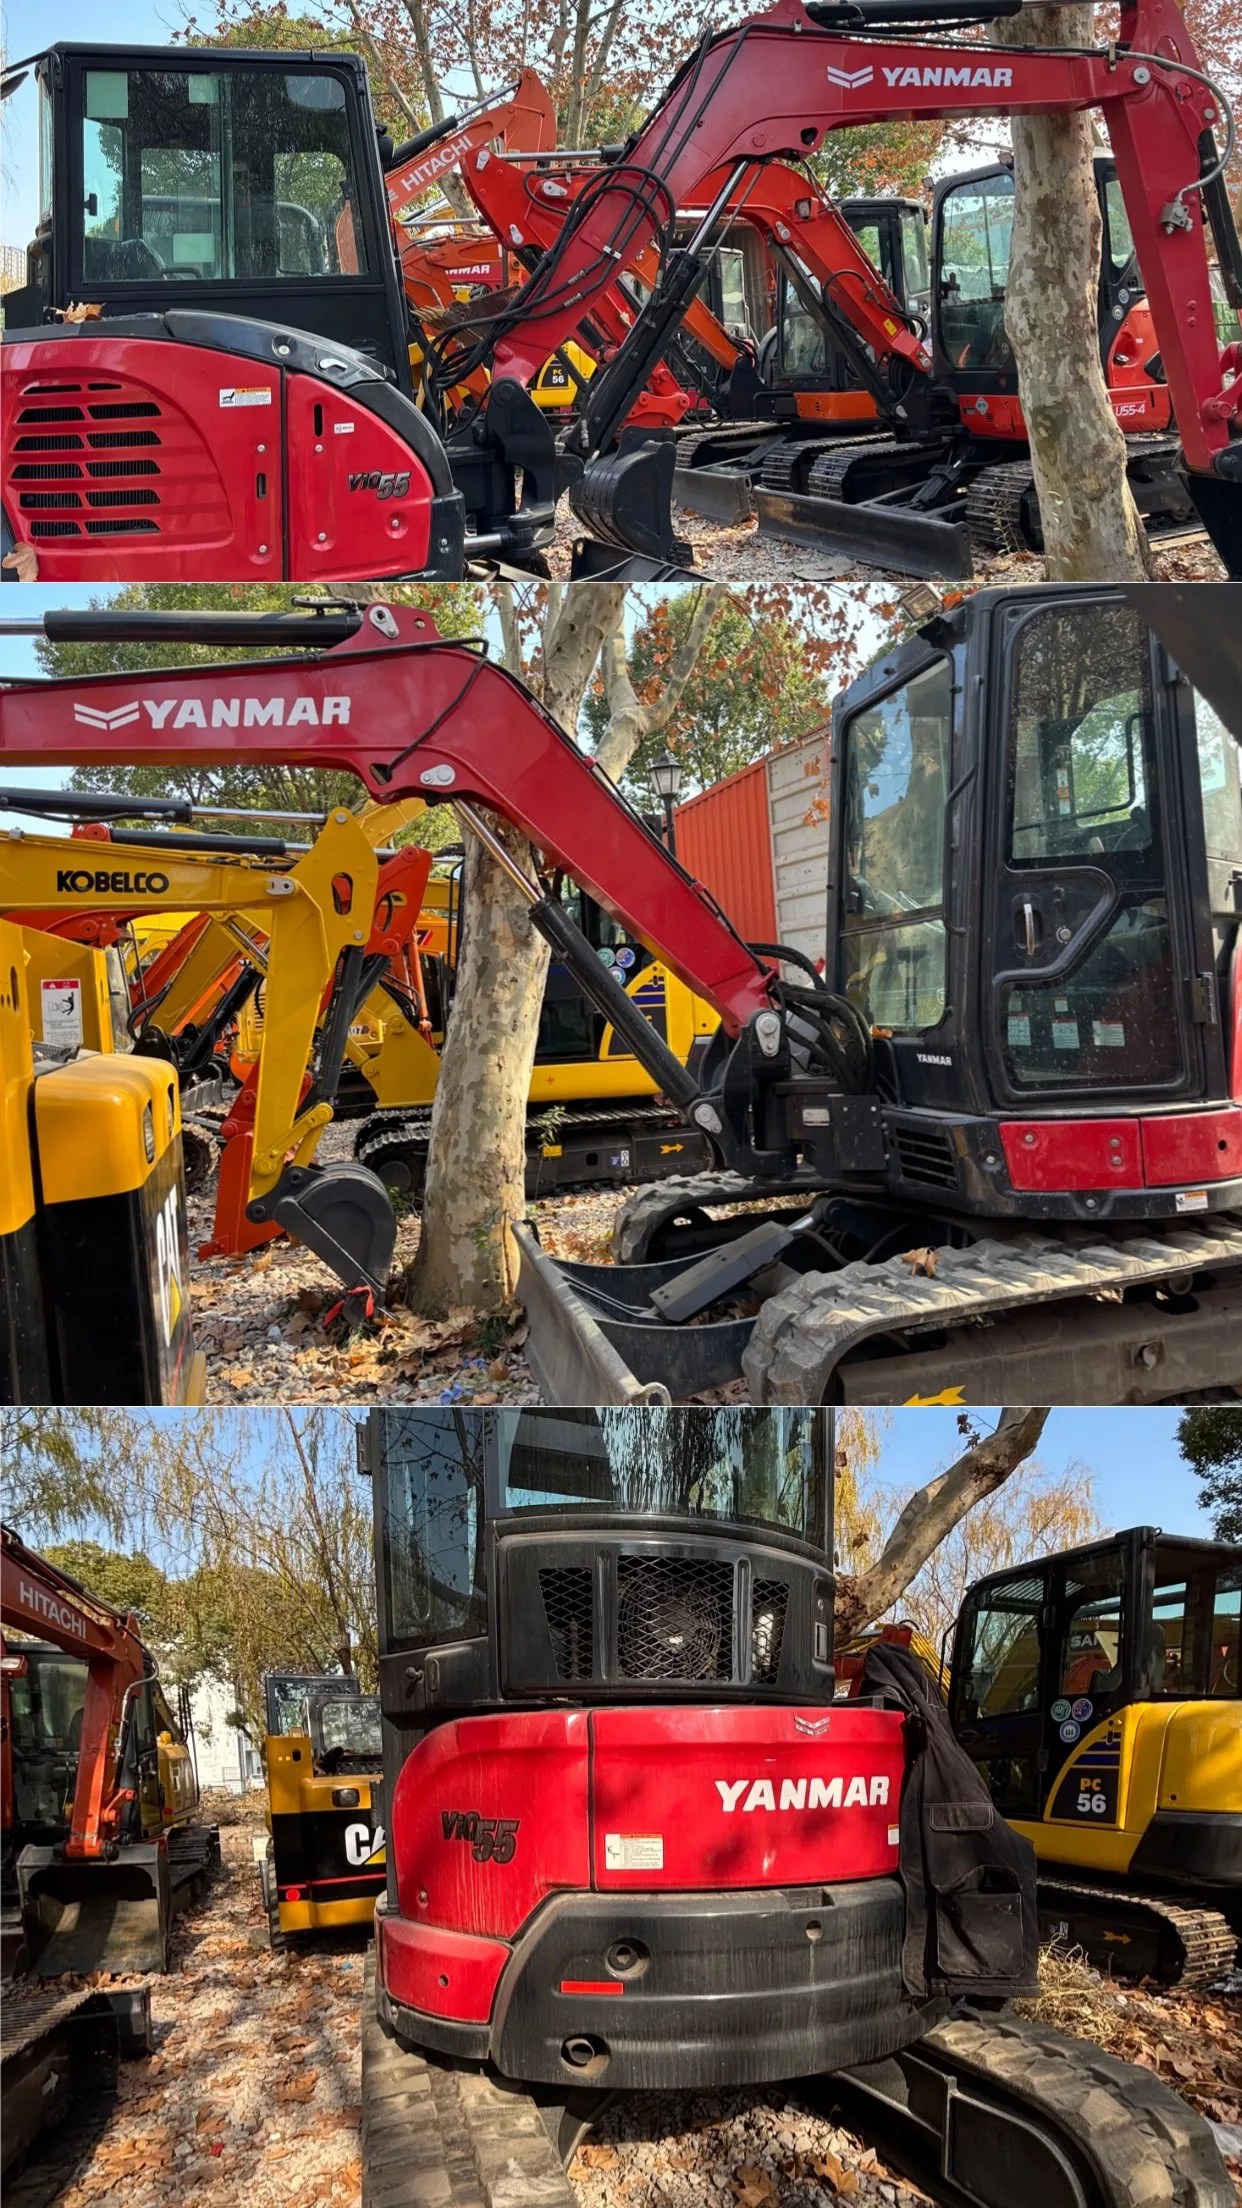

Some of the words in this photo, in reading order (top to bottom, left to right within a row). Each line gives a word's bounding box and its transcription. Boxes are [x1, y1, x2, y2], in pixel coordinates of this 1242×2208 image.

[881, 66, 1013, 88] YANMAR
[401, 135, 473, 192] HITACHI
[552, 375, 565, 384] 56
[142, 696, 351, 730] YANMAR
[57, 870, 169, 894] KOBELCO
[347, 1025, 364, 1036] 07
[916, 1053, 952, 1066] YANMAR
[20, 1580, 86, 1639] HITACHI
[714, 1776, 890, 1812] YANMAR
[1080, 1777, 1102, 1791] PC
[1076, 1793, 1107, 1813] 56
[345, 1823, 386, 1866] CA
